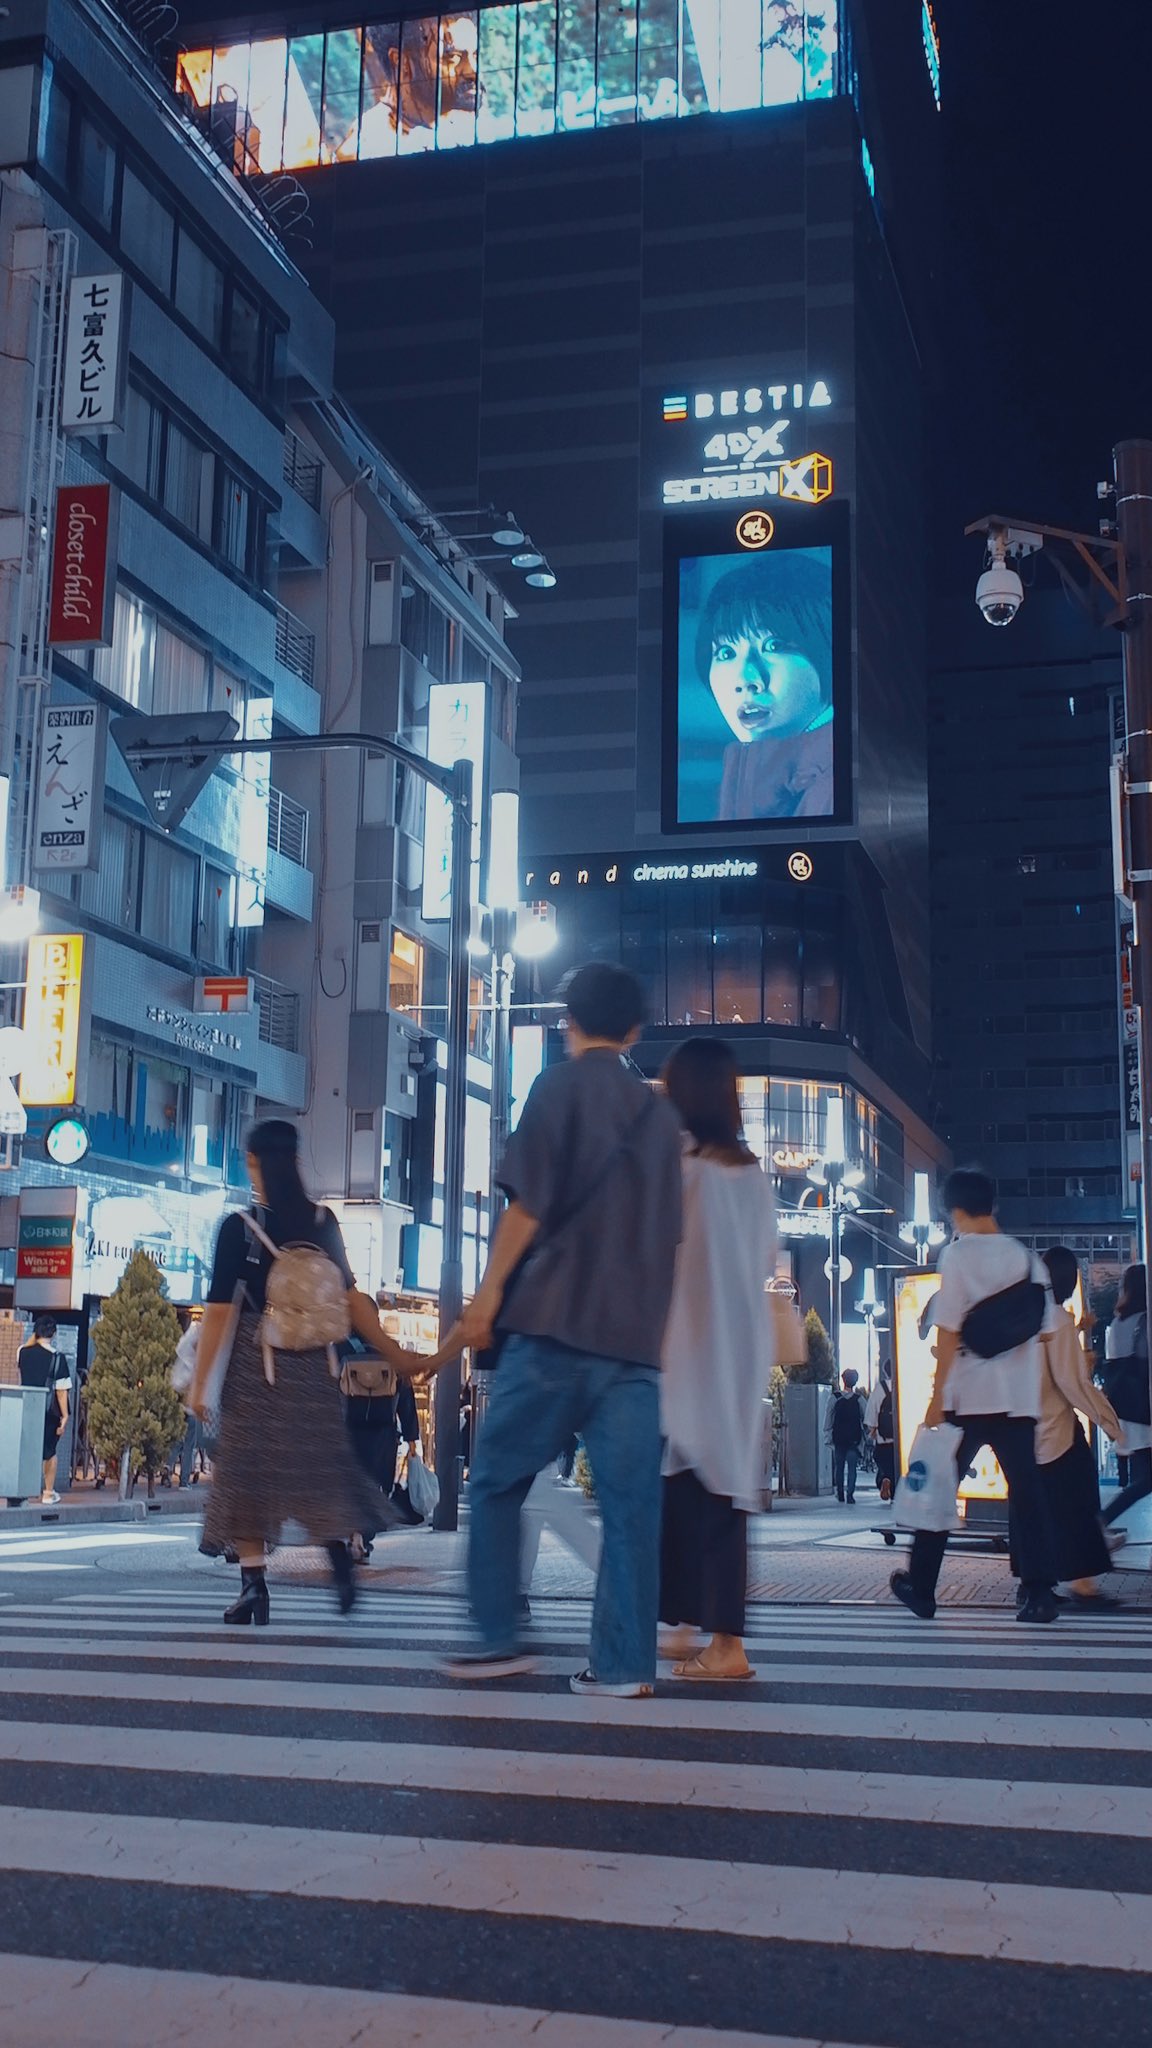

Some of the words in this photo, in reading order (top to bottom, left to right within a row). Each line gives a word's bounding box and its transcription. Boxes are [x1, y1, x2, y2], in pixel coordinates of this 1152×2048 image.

[76, 283, 109, 419] 七富久ビル
[695, 381, 832, 418] BESTIA
[703, 420, 790, 463] 4DX
[45, 733, 88, 824] えんざ
[42, 833, 83, 846] enza
[633, 863, 688, 882] cinema
[691, 859, 758, 879] sunshine
